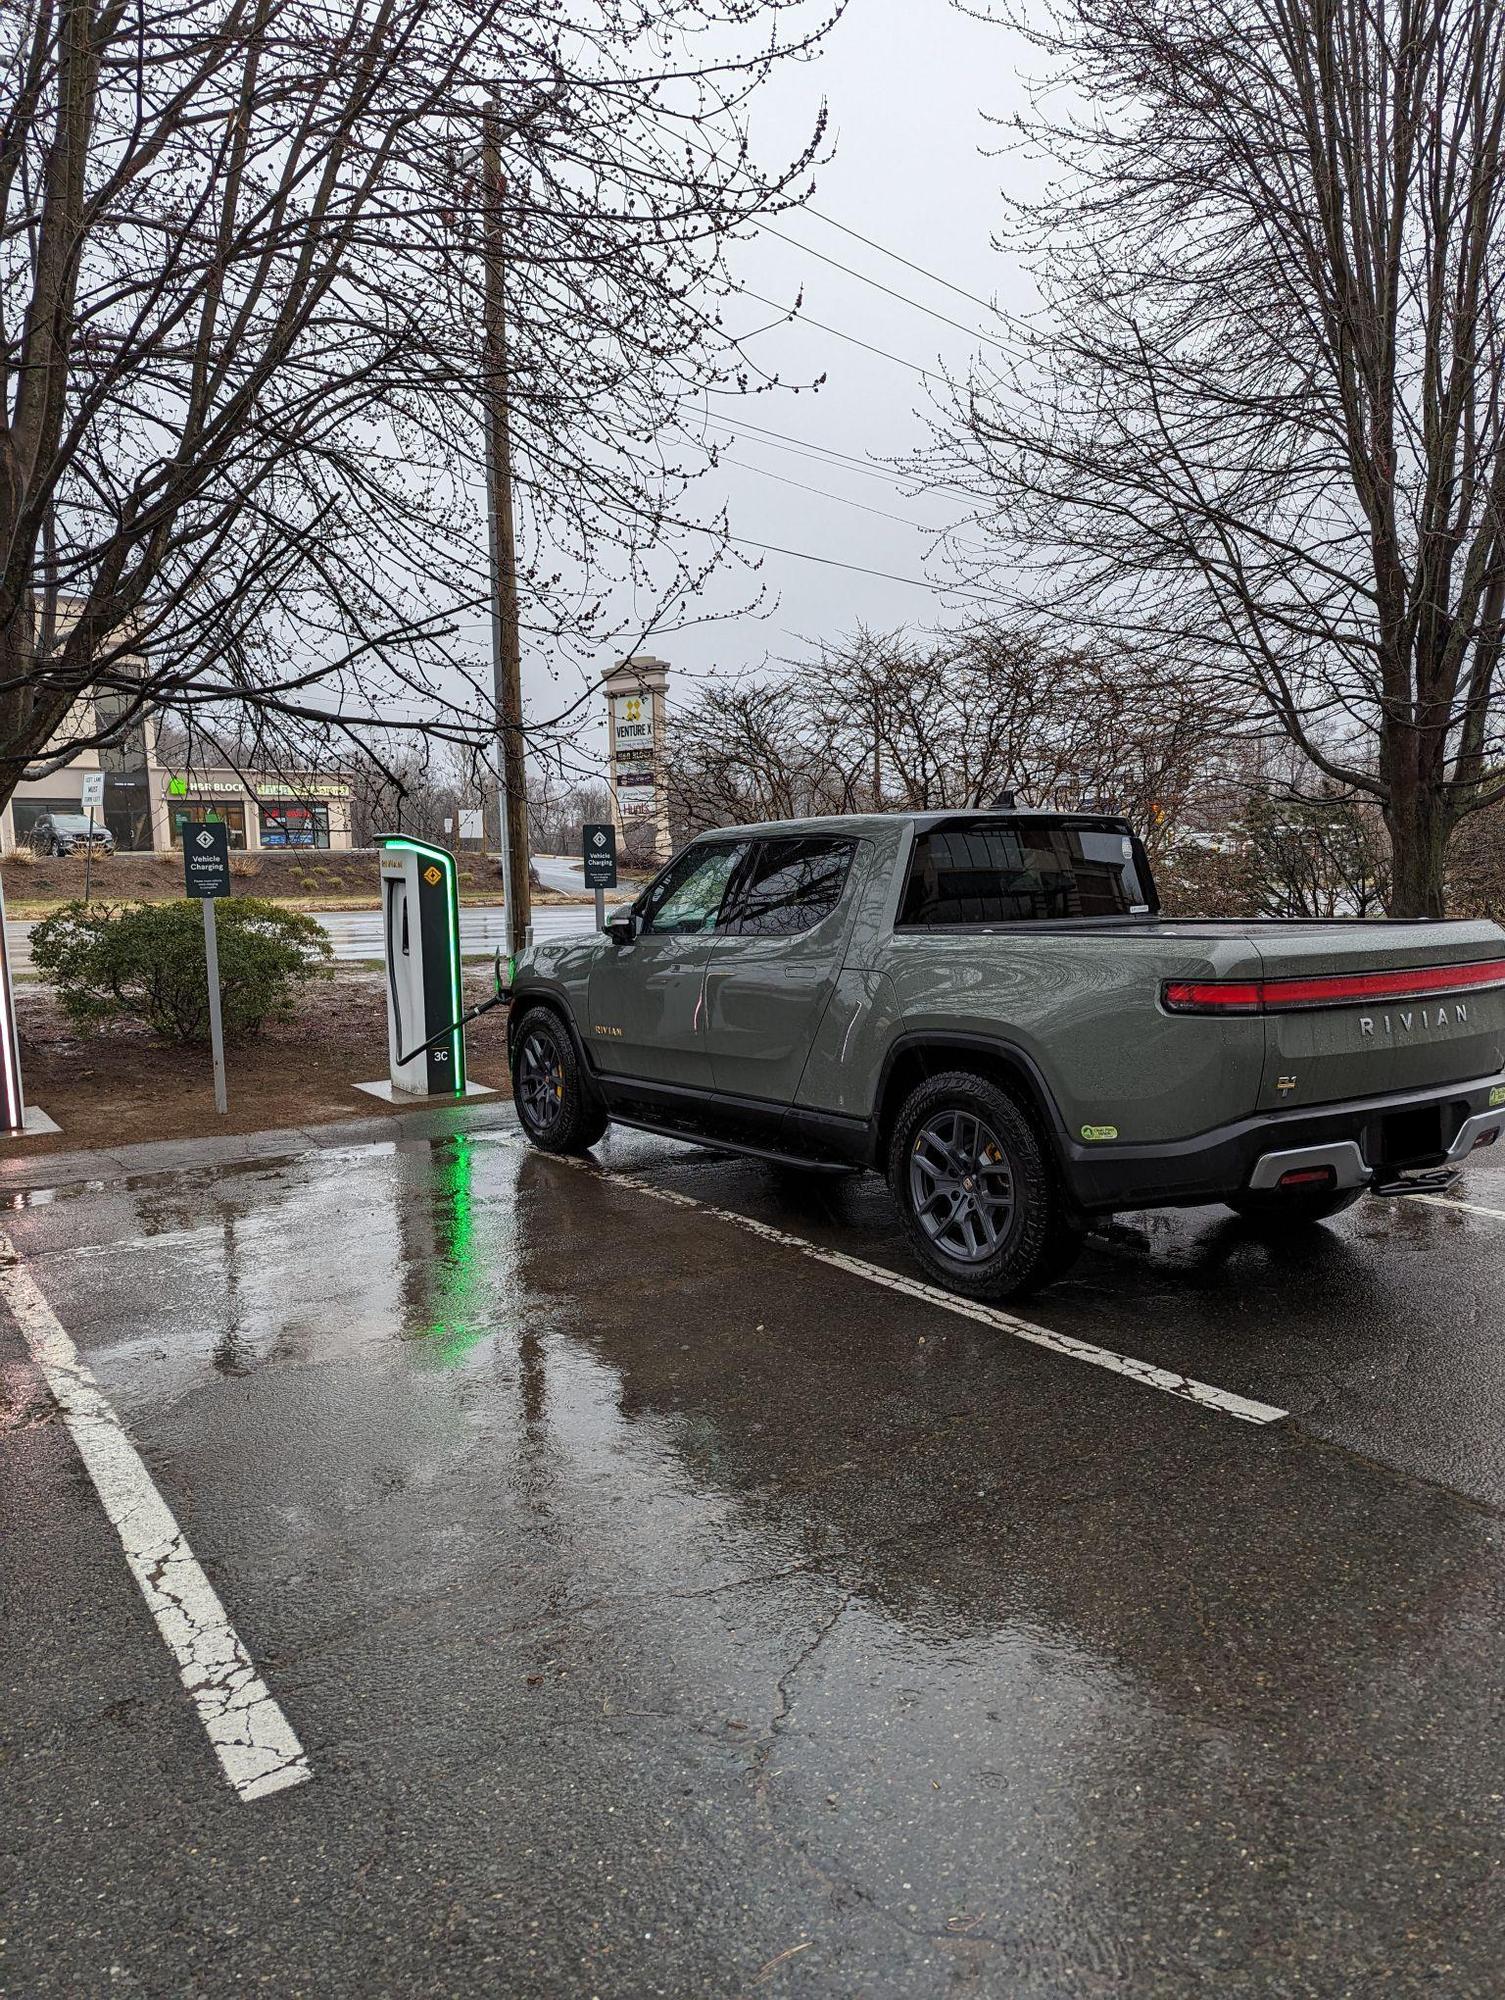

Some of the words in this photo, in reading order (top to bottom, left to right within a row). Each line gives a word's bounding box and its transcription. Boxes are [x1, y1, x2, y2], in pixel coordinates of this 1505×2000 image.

[616, 724, 646, 738] VENTURE
[189, 783, 211, 791] H&R
[214, 783, 245, 792] BLOCK
[192, 855, 221, 863] Vehicle
[588, 859, 613, 867] Charging
[190, 863, 224, 872] Charging
[1360, 1004, 1468, 1036] RIVIAN
[595, 1025, 622, 1036] RIVIAN
[434, 1051, 448, 1062] 3C
